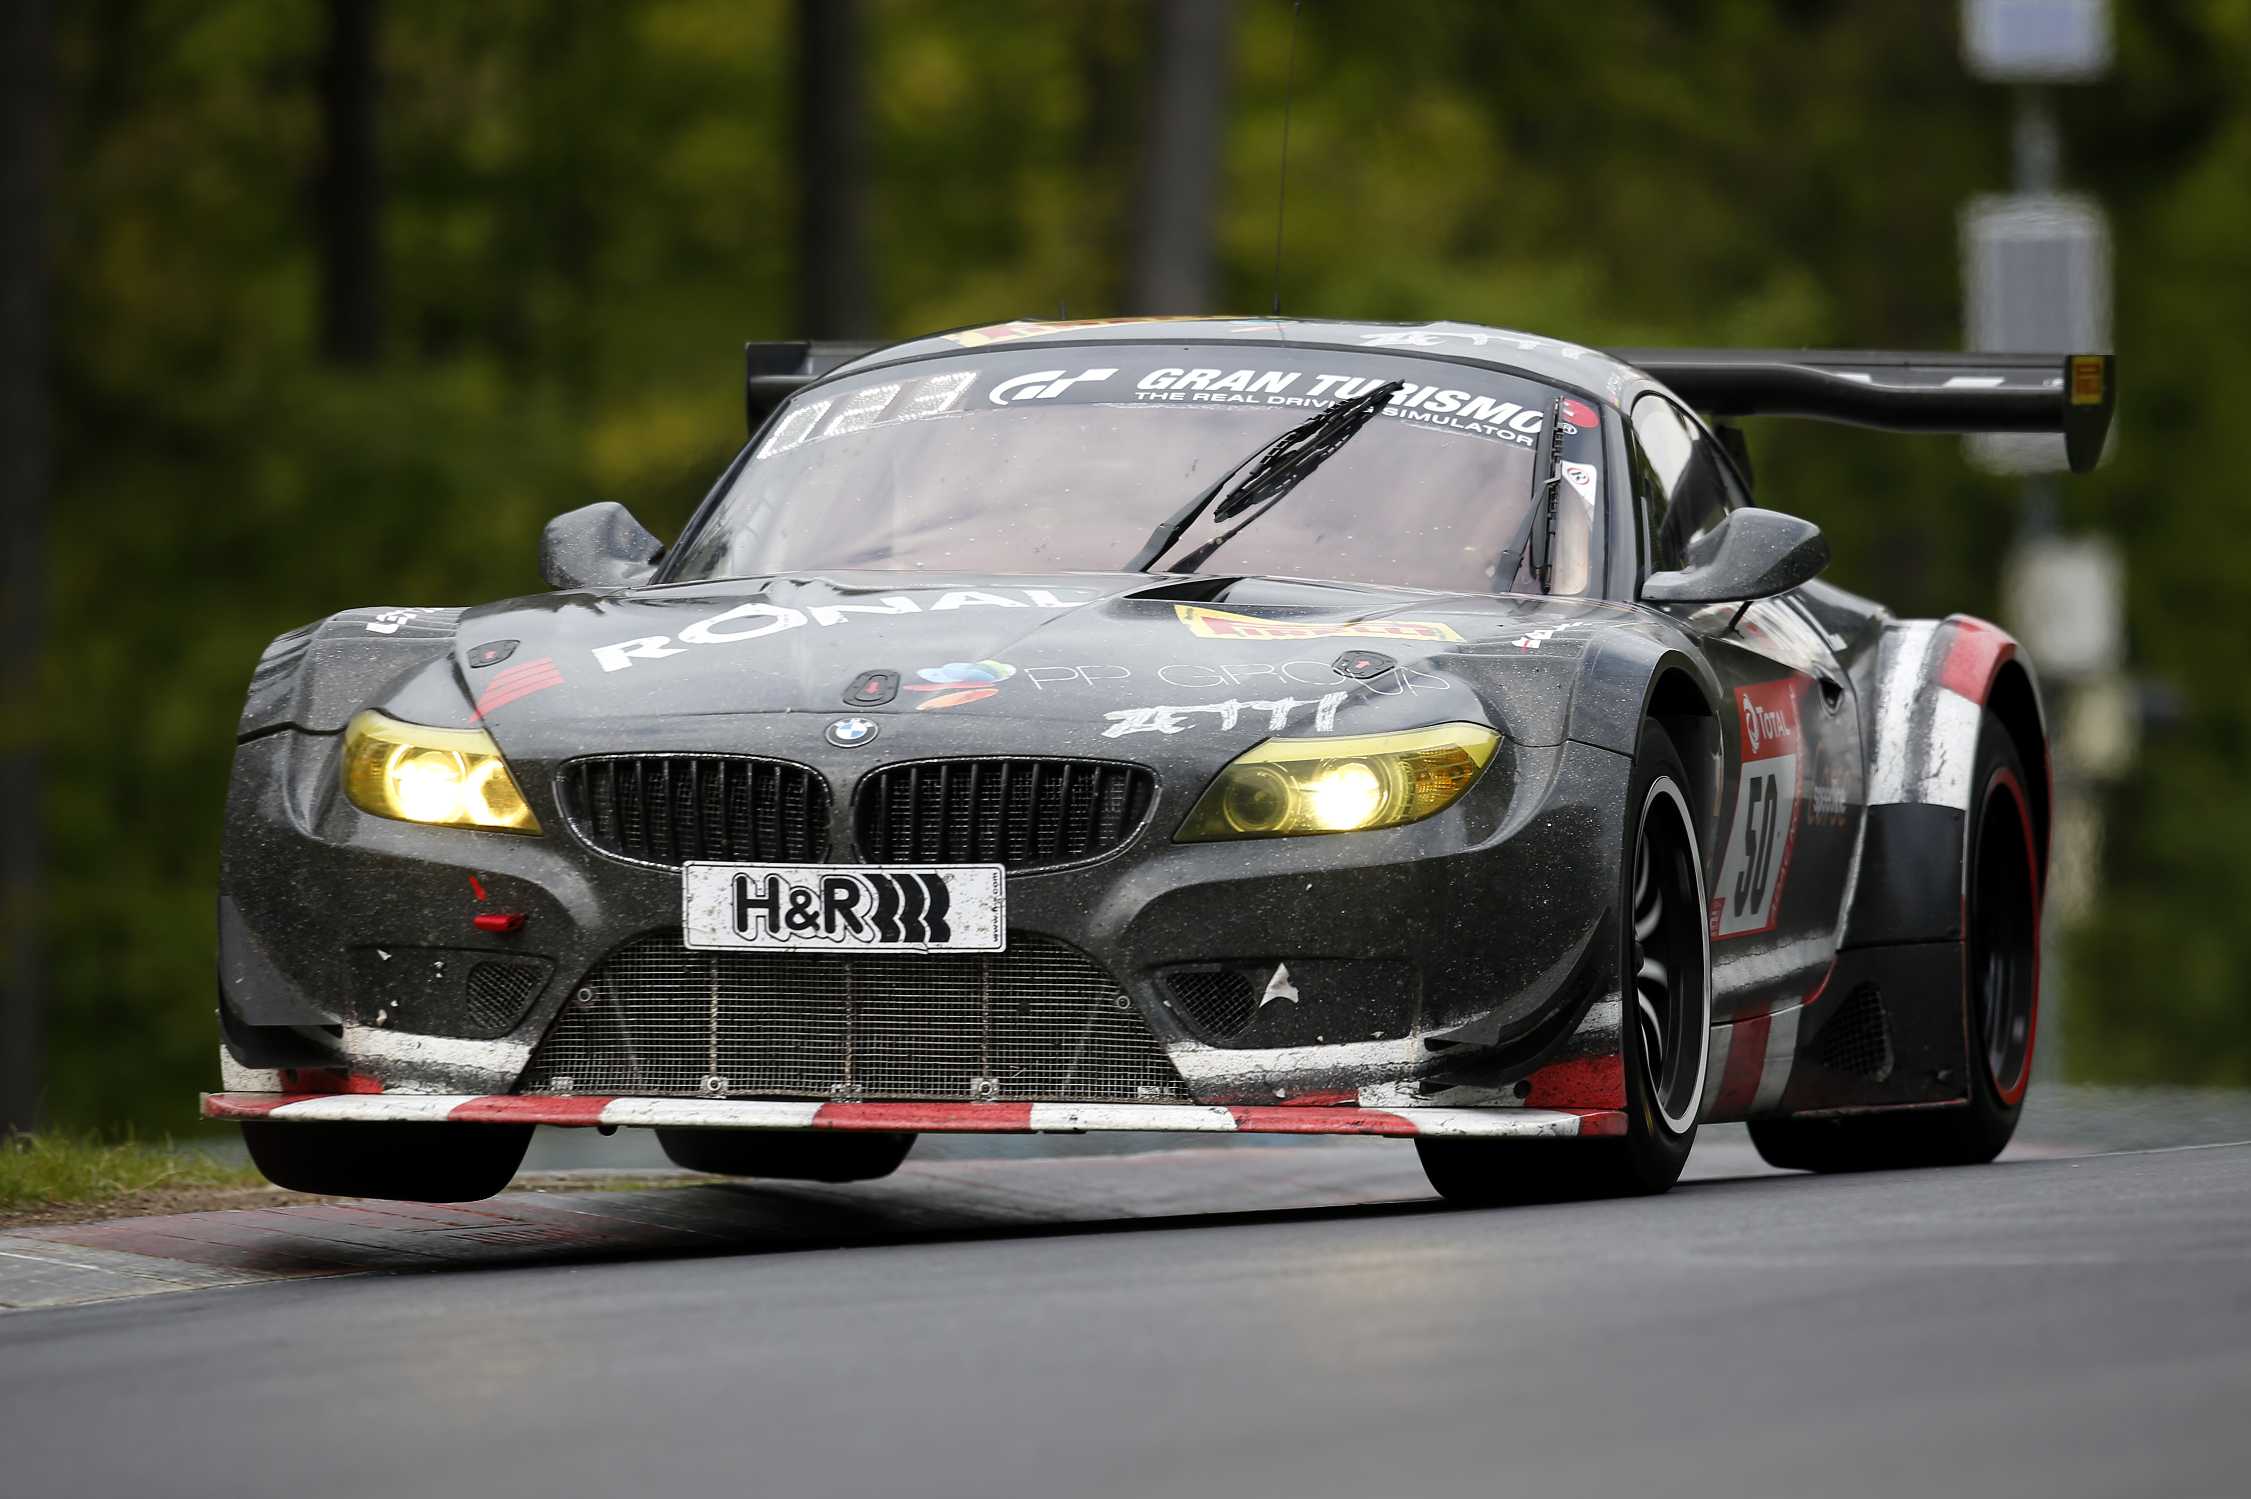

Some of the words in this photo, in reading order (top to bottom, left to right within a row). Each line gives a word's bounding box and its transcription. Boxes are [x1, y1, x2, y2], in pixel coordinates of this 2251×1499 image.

[1136, 368, 1302, 393] GRAN
[1305, 374, 1544, 434] TURISMO
[1136, 392, 1186, 401] THE
[1192, 393, 1260, 404] REAL
[1381, 406, 1535, 447] SIMULATOR
[592, 589, 1098, 672] RONAL
[1024, 664, 1131, 690] PP
[1157, 661, 1450, 696] GROUP
[1101, 690, 1348, 738] ZETTI
[1755, 705, 1791, 740] TOTAL
[1734, 774, 1778, 918] 50
[733, 873, 870, 937] H&R
